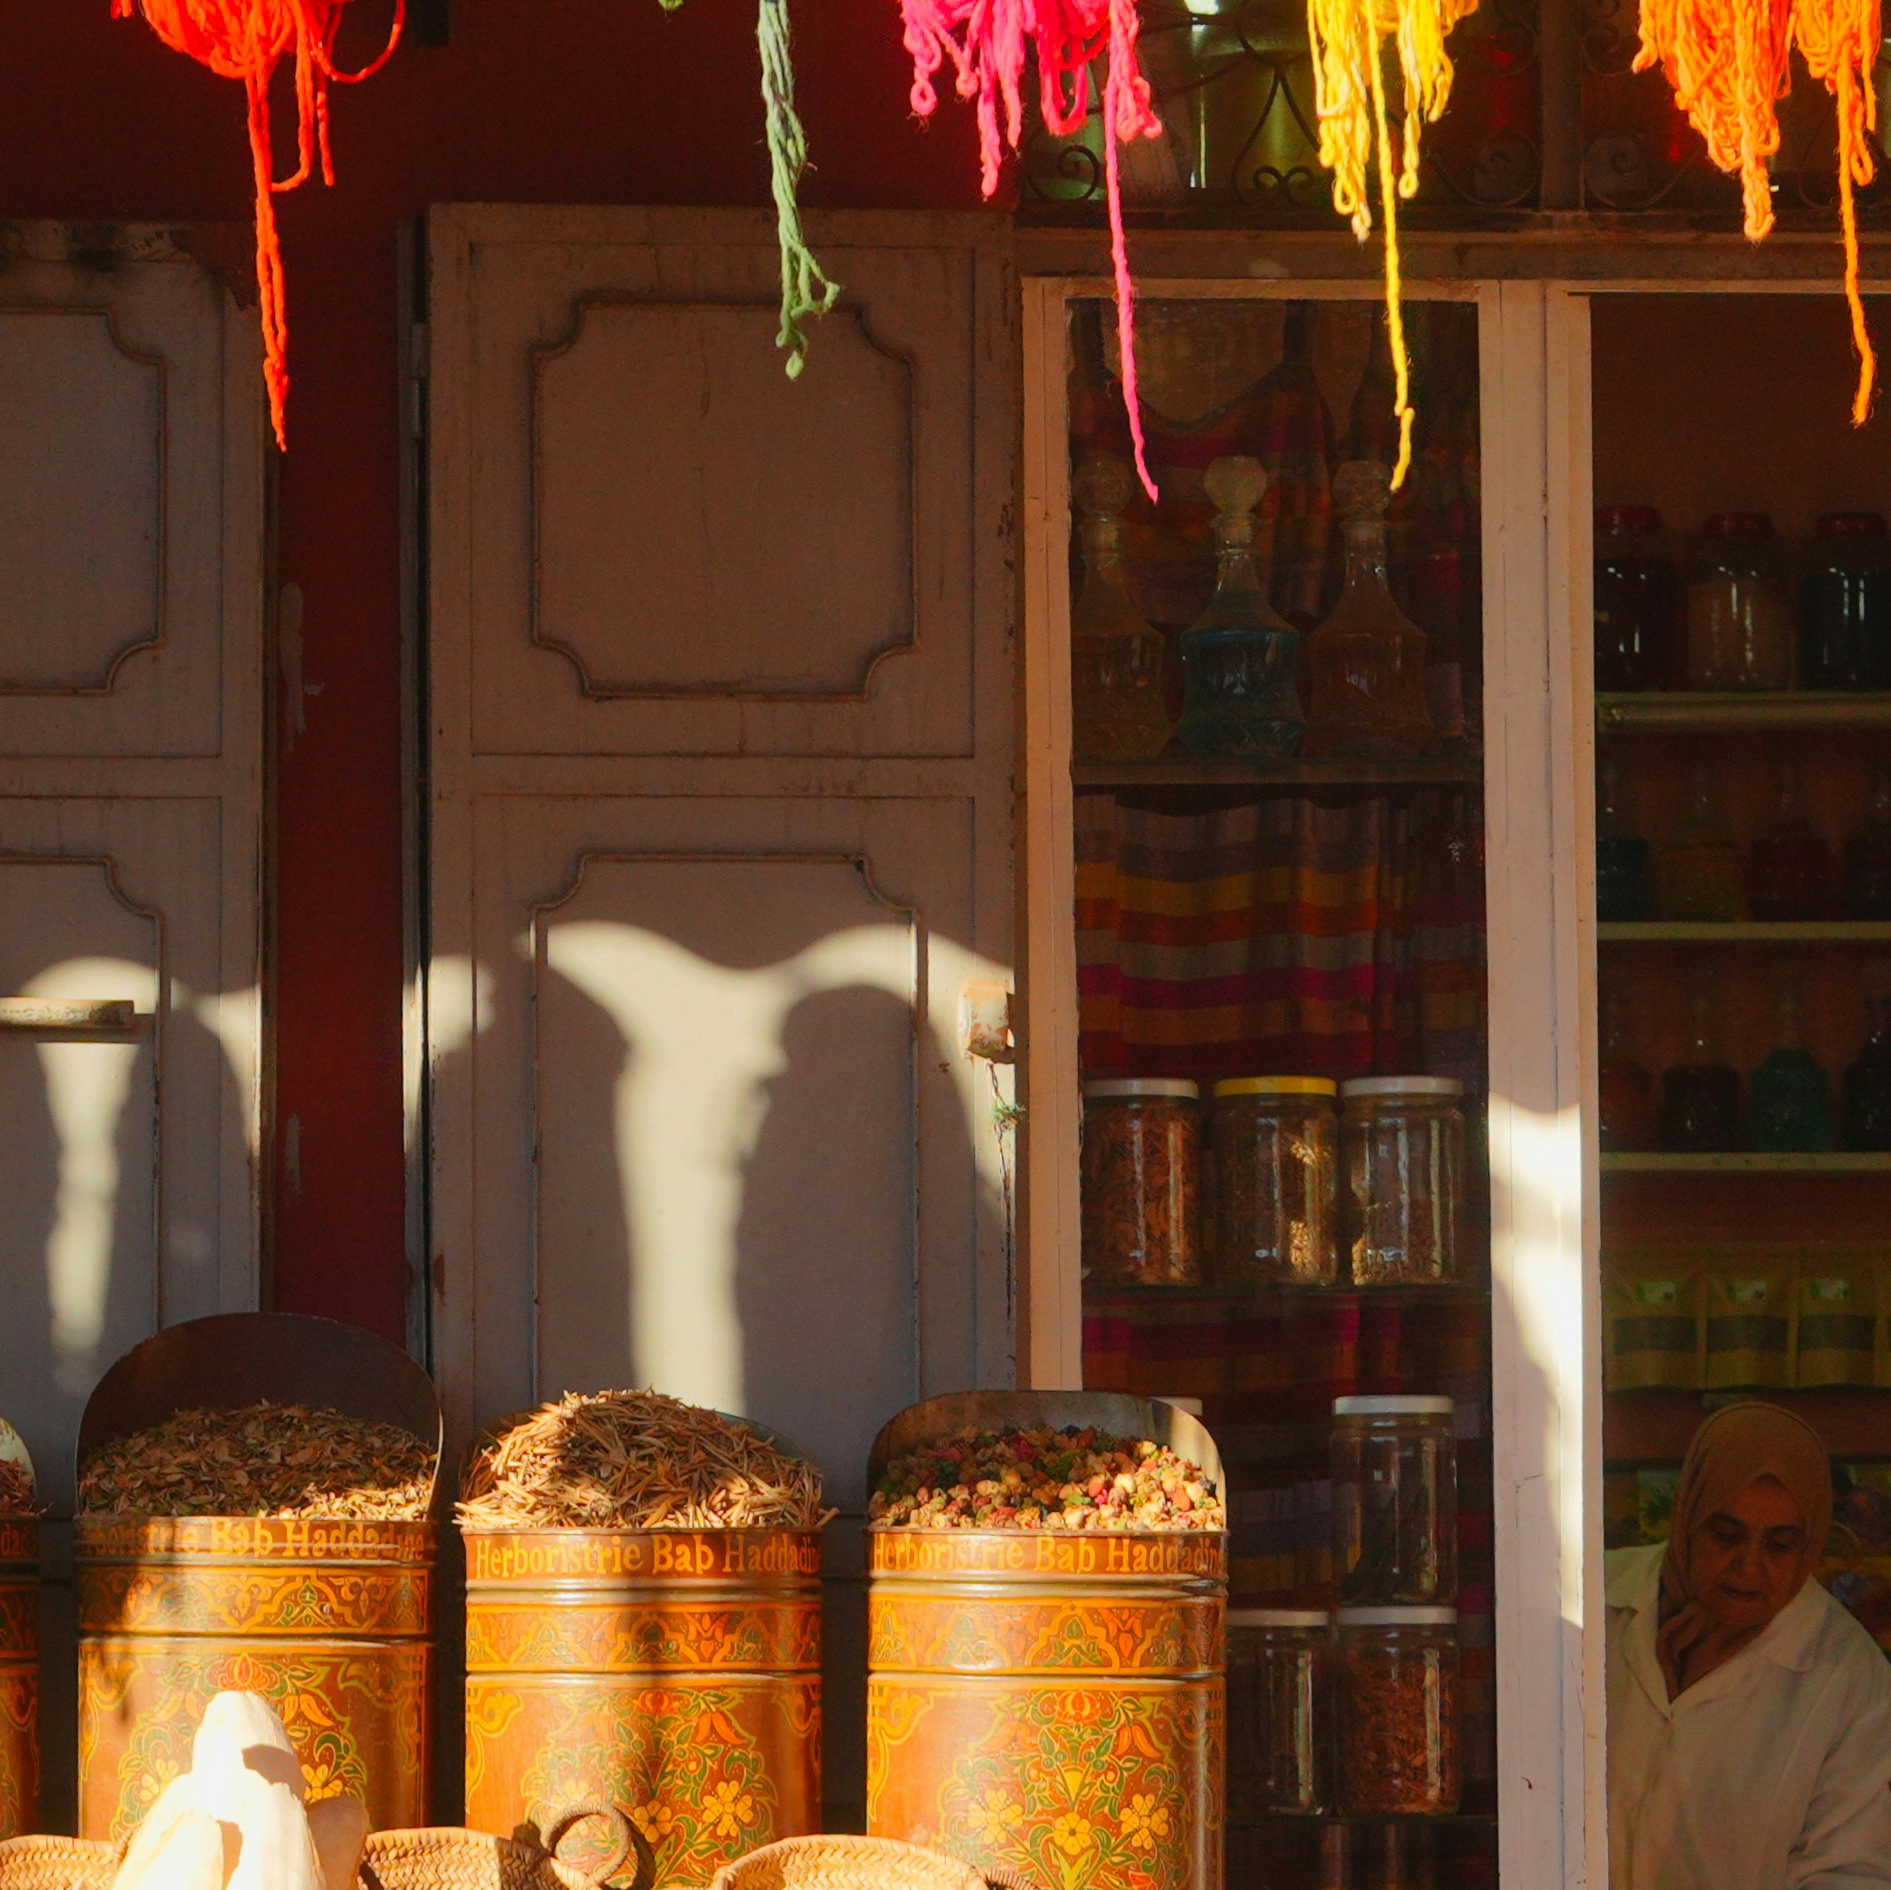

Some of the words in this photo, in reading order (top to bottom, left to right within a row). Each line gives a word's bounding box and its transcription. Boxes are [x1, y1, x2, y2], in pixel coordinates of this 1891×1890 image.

[212, 1519, 273, 1558] Bab
[652, 1535, 714, 1575] Bab
[1033, 1535, 1096, 1574] Bab
